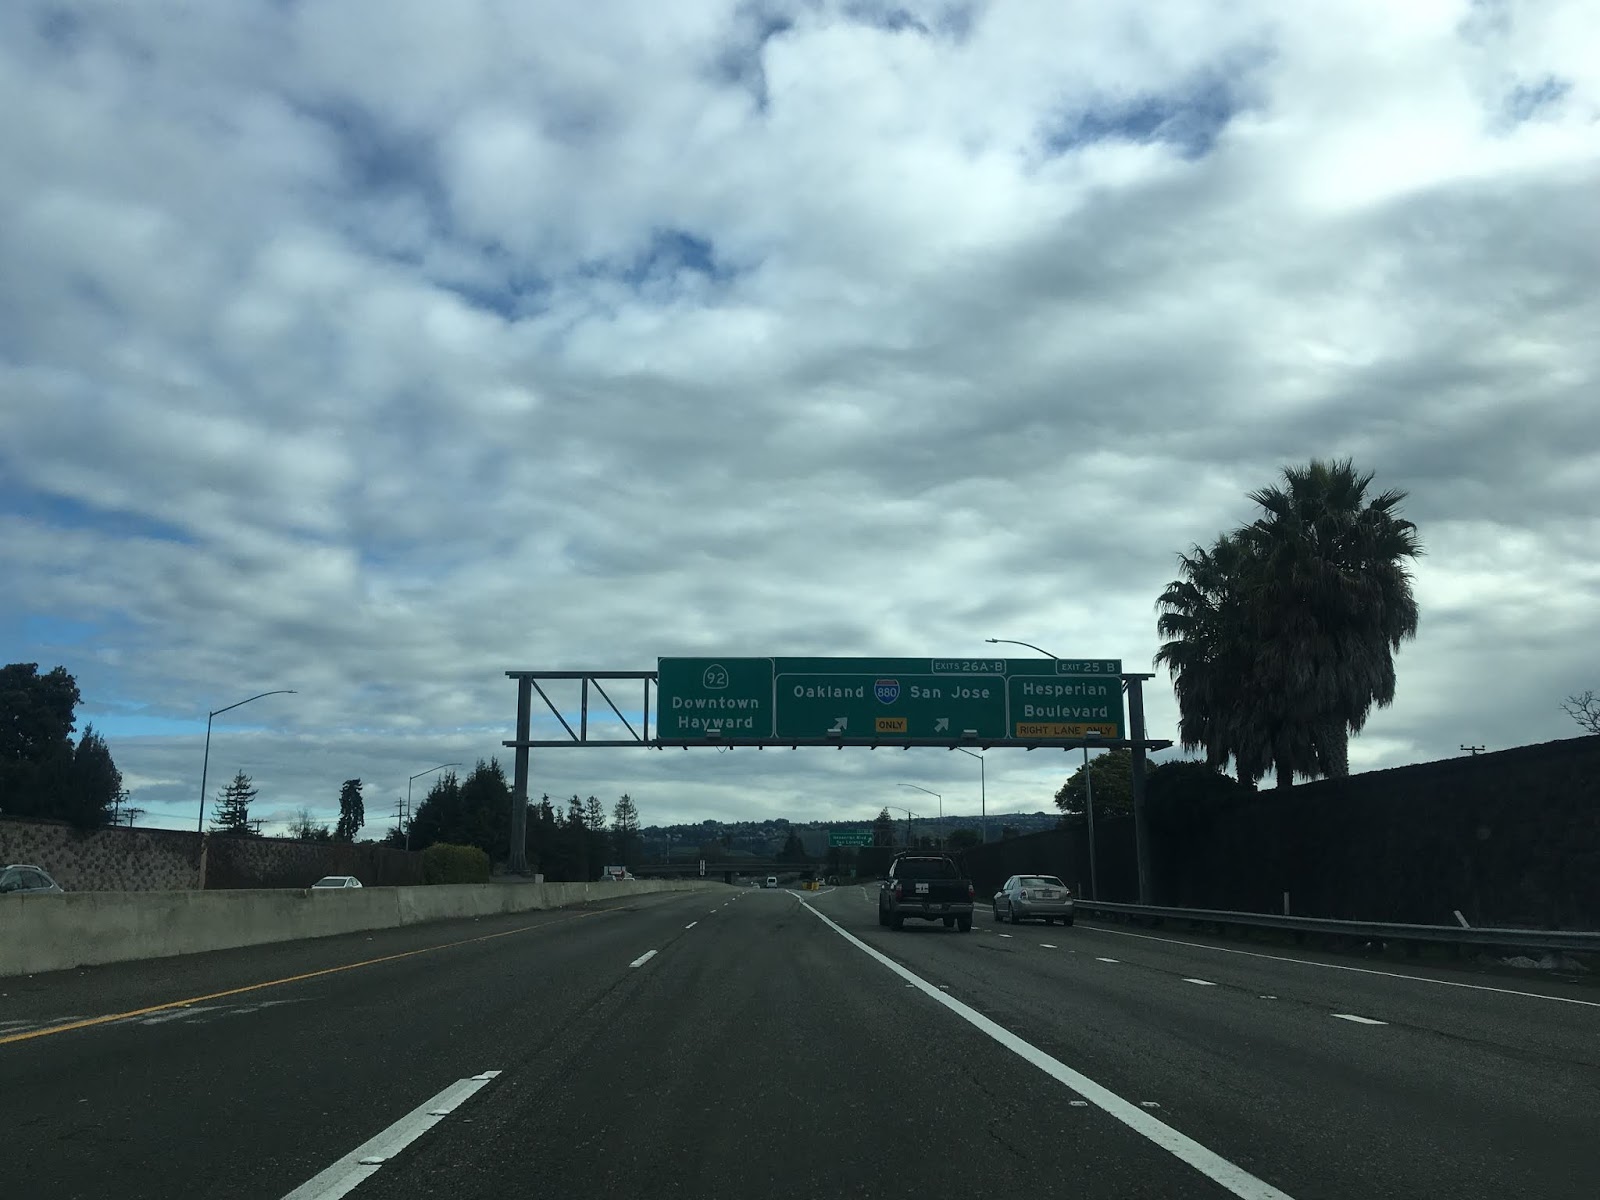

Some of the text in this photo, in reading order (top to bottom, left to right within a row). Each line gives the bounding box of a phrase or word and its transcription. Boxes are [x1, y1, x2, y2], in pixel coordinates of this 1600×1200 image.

[935, 661, 1003, 671] EXITS 26A-B
[1061, 662, 1115, 672] EXIT 25 B
[707, 672, 725, 684] 92
[793, 685, 864, 698] Oakland
[877, 687, 897, 698] 880
[910, 685, 990, 699] San Jose
[1023, 682, 1107, 697] Hesperian
[672, 696, 759, 709] Downtown
[1024, 704, 1108, 718] Boulevard
[678, 716, 753, 731] Hayward
[878, 721, 903, 729] ONLY
[1020, 726, 1048, 735] RIGHT
[1054, 726, 1080, 735] LANE
